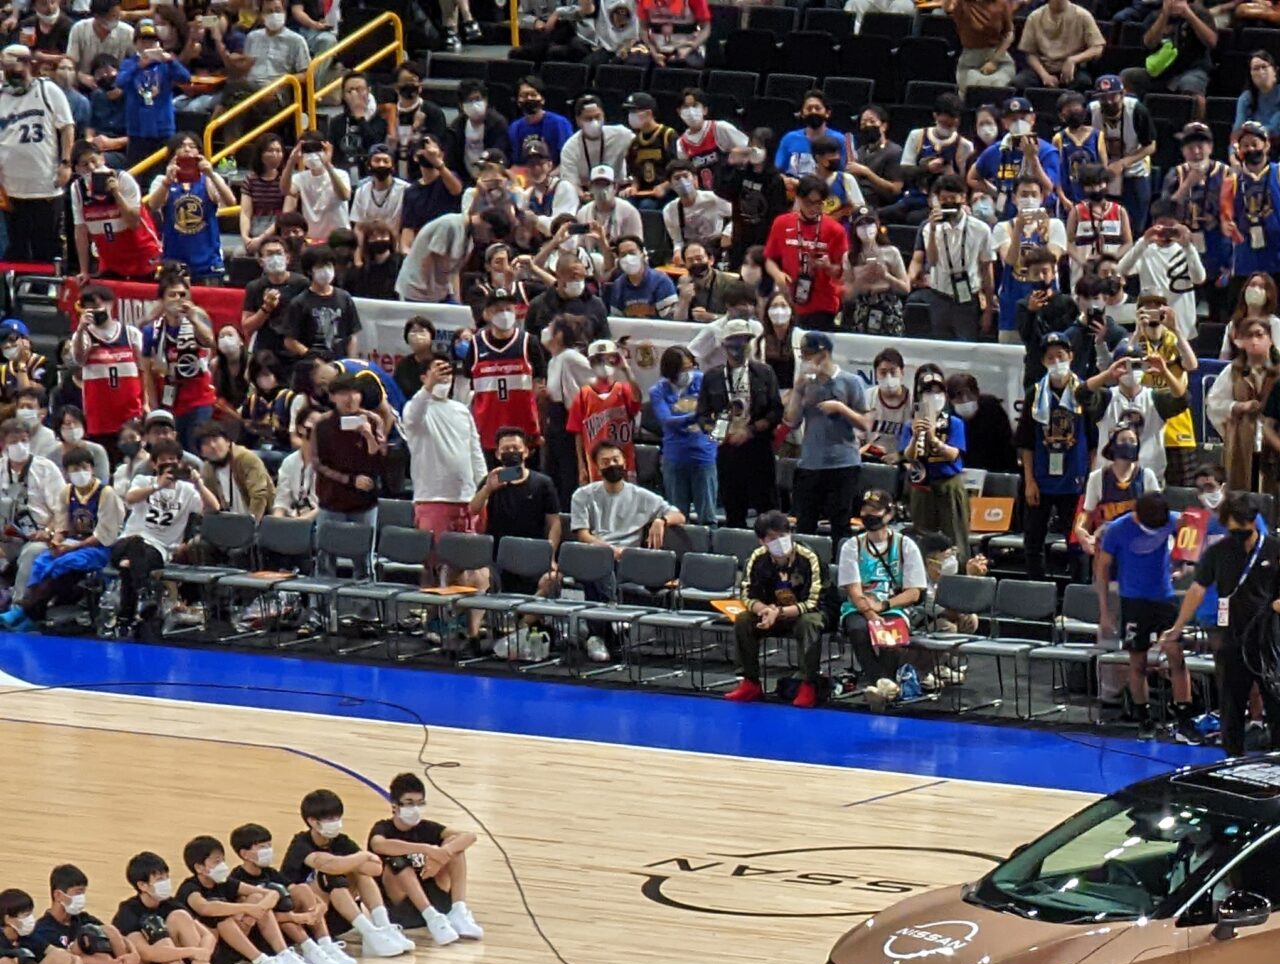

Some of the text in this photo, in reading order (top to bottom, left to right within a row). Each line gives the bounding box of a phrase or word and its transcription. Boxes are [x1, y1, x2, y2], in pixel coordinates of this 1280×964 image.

[19, 123, 45, 144] 23
[145, 508, 174, 527] 22
[896, 927, 968, 950] NISSAN
